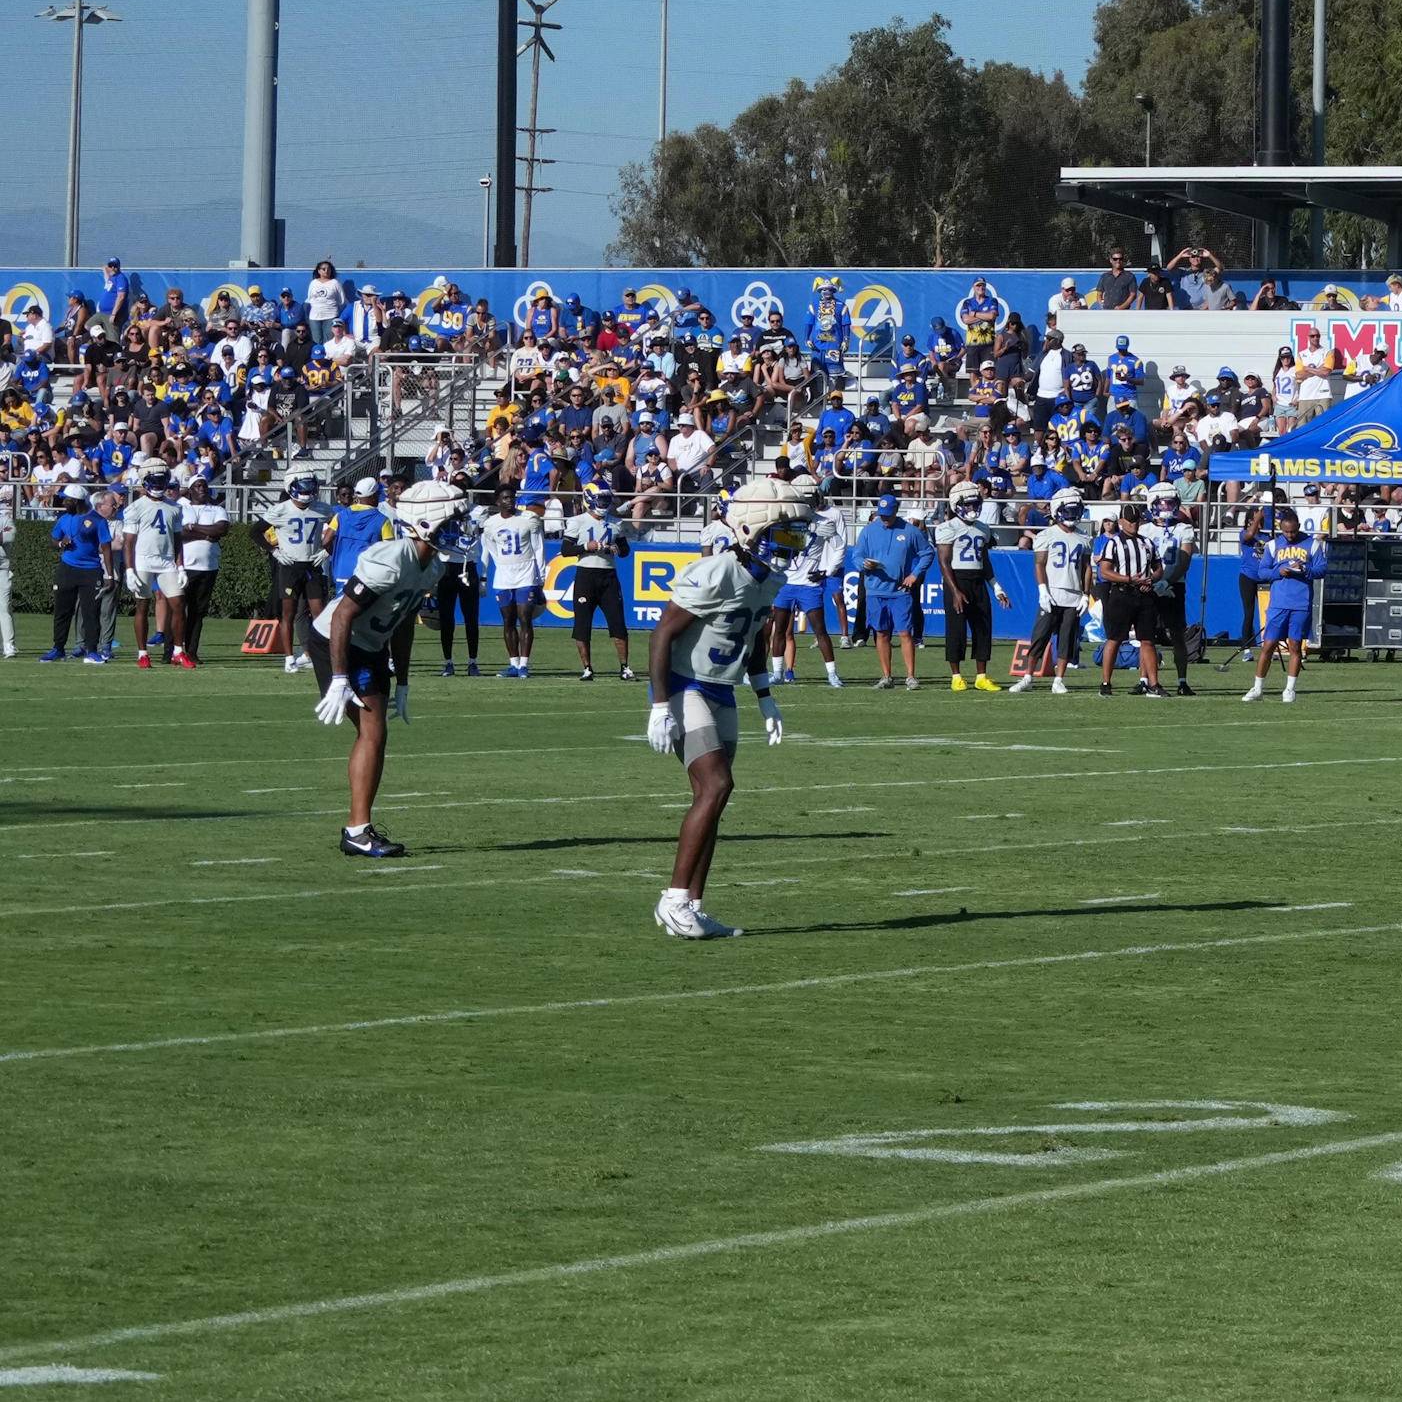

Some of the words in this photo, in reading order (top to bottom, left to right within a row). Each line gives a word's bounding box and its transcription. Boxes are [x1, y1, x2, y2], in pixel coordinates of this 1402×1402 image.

[1070, 371, 1094, 392] 29
[1275, 374, 1293, 394] 12
[1057, 418, 1080, 442] 82
[111, 450, 125, 469] 9
[151, 509, 167, 535] 4
[288, 517, 319, 544] 37
[497, 529, 522, 555] 31
[1052, 541, 1083, 570] 34
[1277, 548, 1308, 565] RAMS
[245, 623, 273, 648] 40
